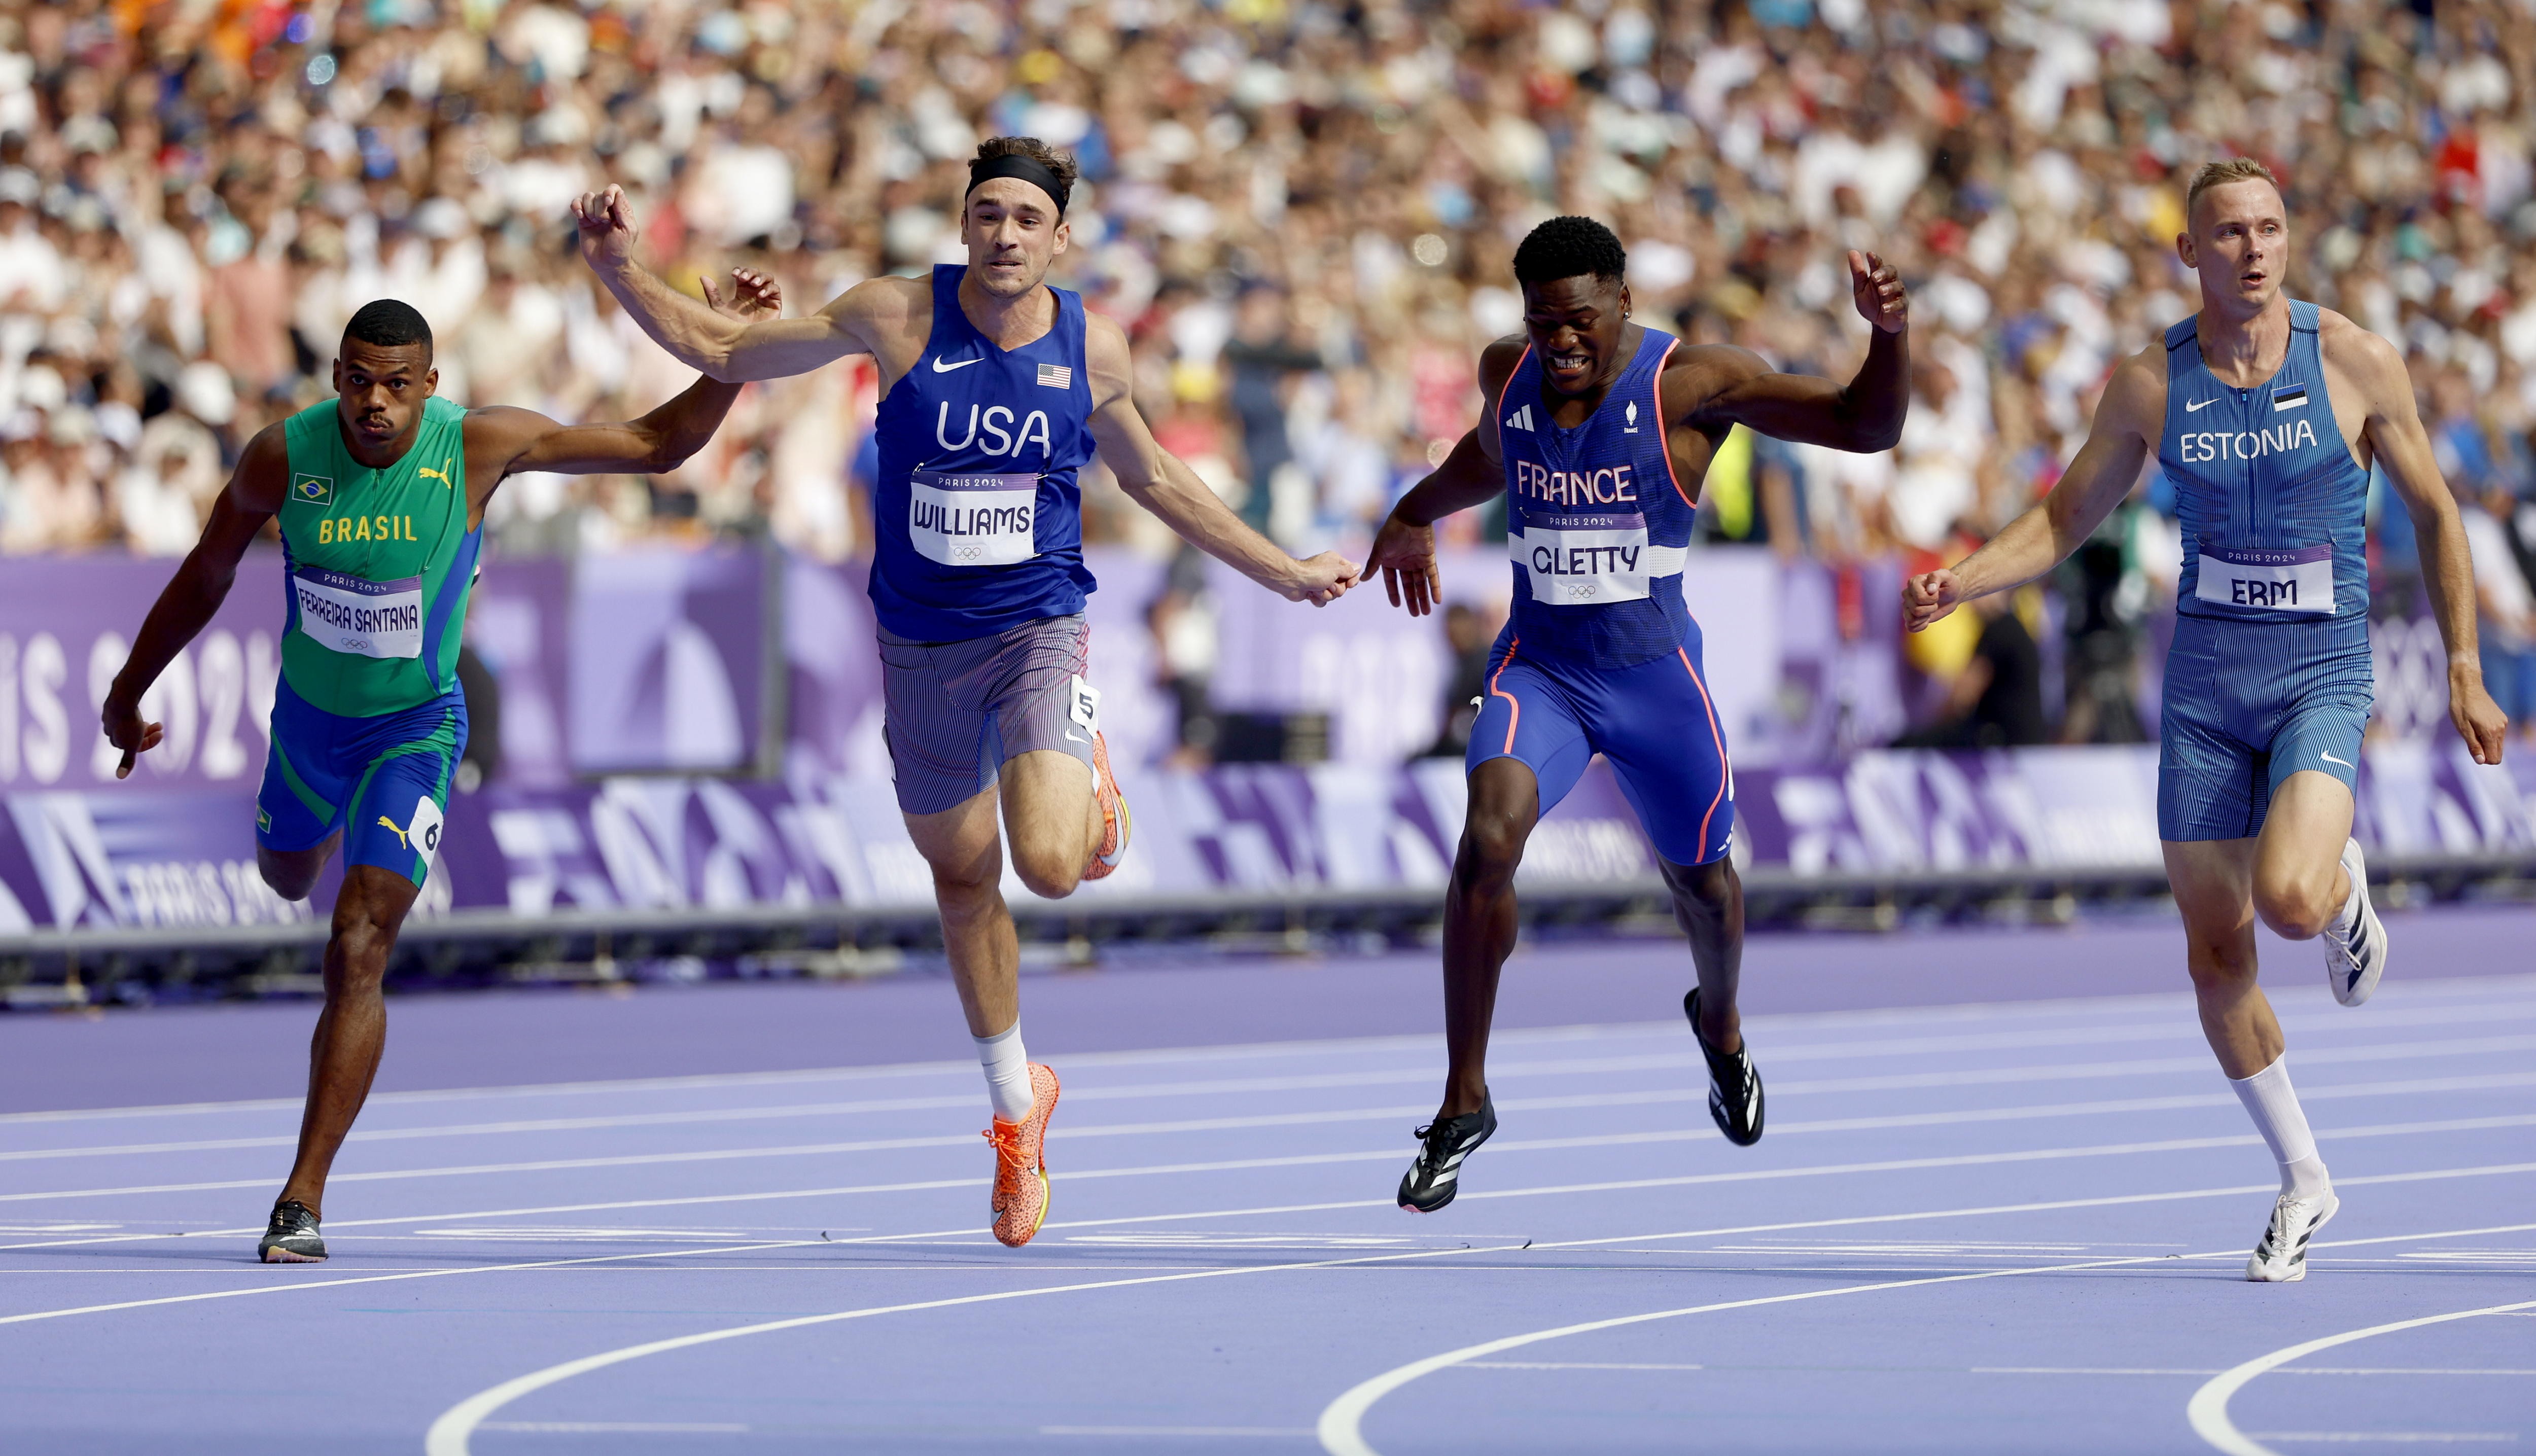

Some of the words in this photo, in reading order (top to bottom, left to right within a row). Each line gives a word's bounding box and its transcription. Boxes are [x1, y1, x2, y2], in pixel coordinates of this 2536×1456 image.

[936, 401, 1051, 459] USA
[2180, 419, 2317, 463] ESTONIA
[974, 478, 1003, 487] 2024
[1517, 460, 1637, 506] FRANCE
[319, 515, 417, 544] BRASIL
[914, 500, 1030, 536] WILLIAMS
[1583, 517, 1613, 526] 2024
[1532, 545, 1640, 575] GLETTY
[358, 582, 386, 592] 2024
[2231, 578, 2297, 606] ERM
[298, 587, 351, 630] FERREIRA
[355, 604, 418, 633] SANTANA
[1079, 692, 1094, 720] 5
[425, 822, 439, 851] 6
